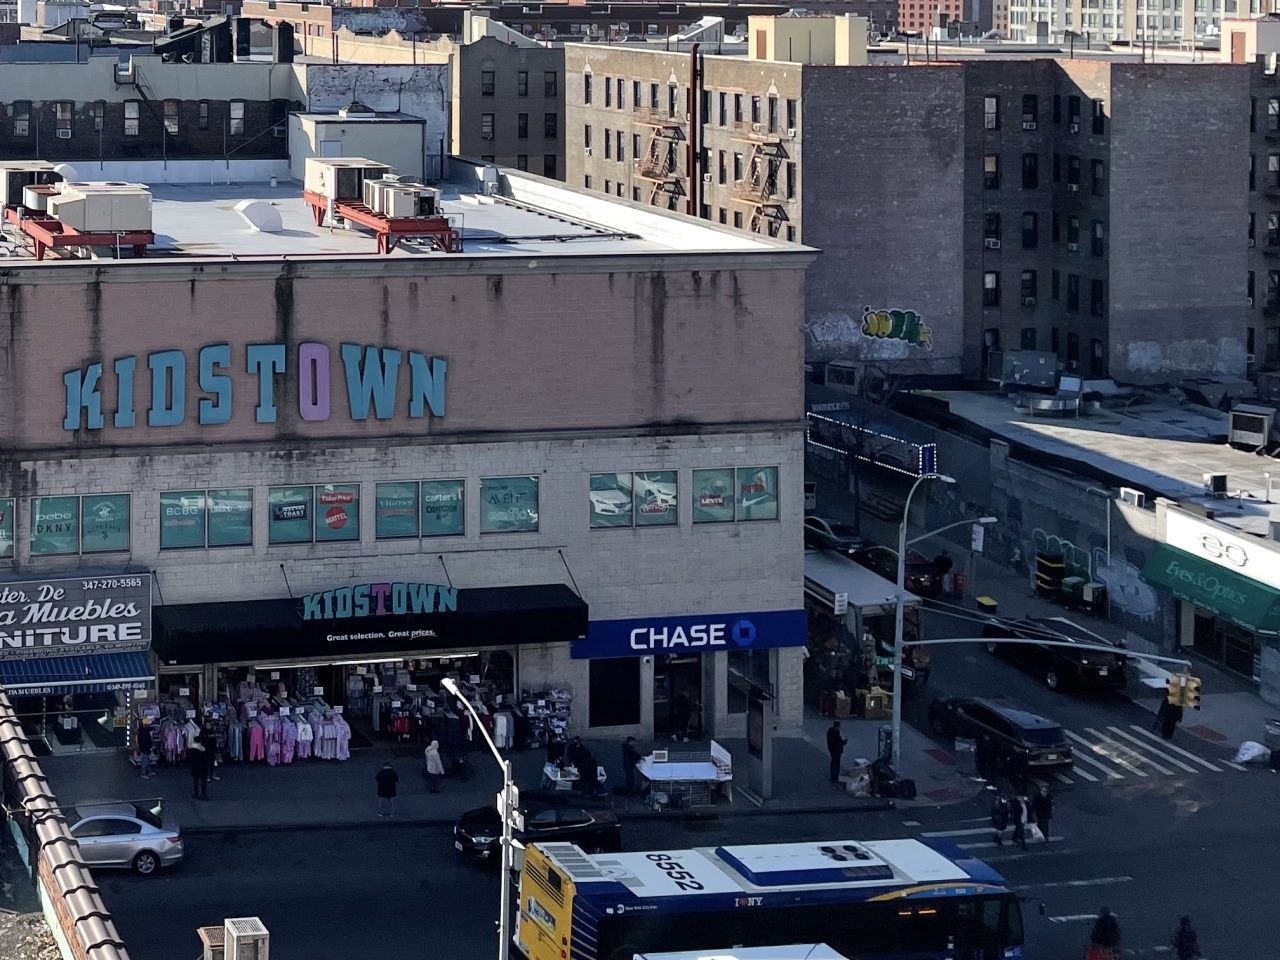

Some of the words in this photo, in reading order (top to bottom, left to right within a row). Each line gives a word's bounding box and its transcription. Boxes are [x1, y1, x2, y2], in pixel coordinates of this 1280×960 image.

[63, 342, 448, 430] KIDSTOWN
[166, 505, 198, 516] BCBG
[37, 523, 72, 534] DKNY
[37, 585, 65, 601] De
[82, 578, 142, 590] 347-270-5565
[303, 582, 458, 620] KIDSTOWN
[22, 599, 142, 624] Muebles
[327, 634, 349, 642] Great
[350, 632, 385, 640] selection.
[388, 630, 410, 638] Great
[630, 624, 726, 649] CHASE
[646, 853, 705, 891] 8552
